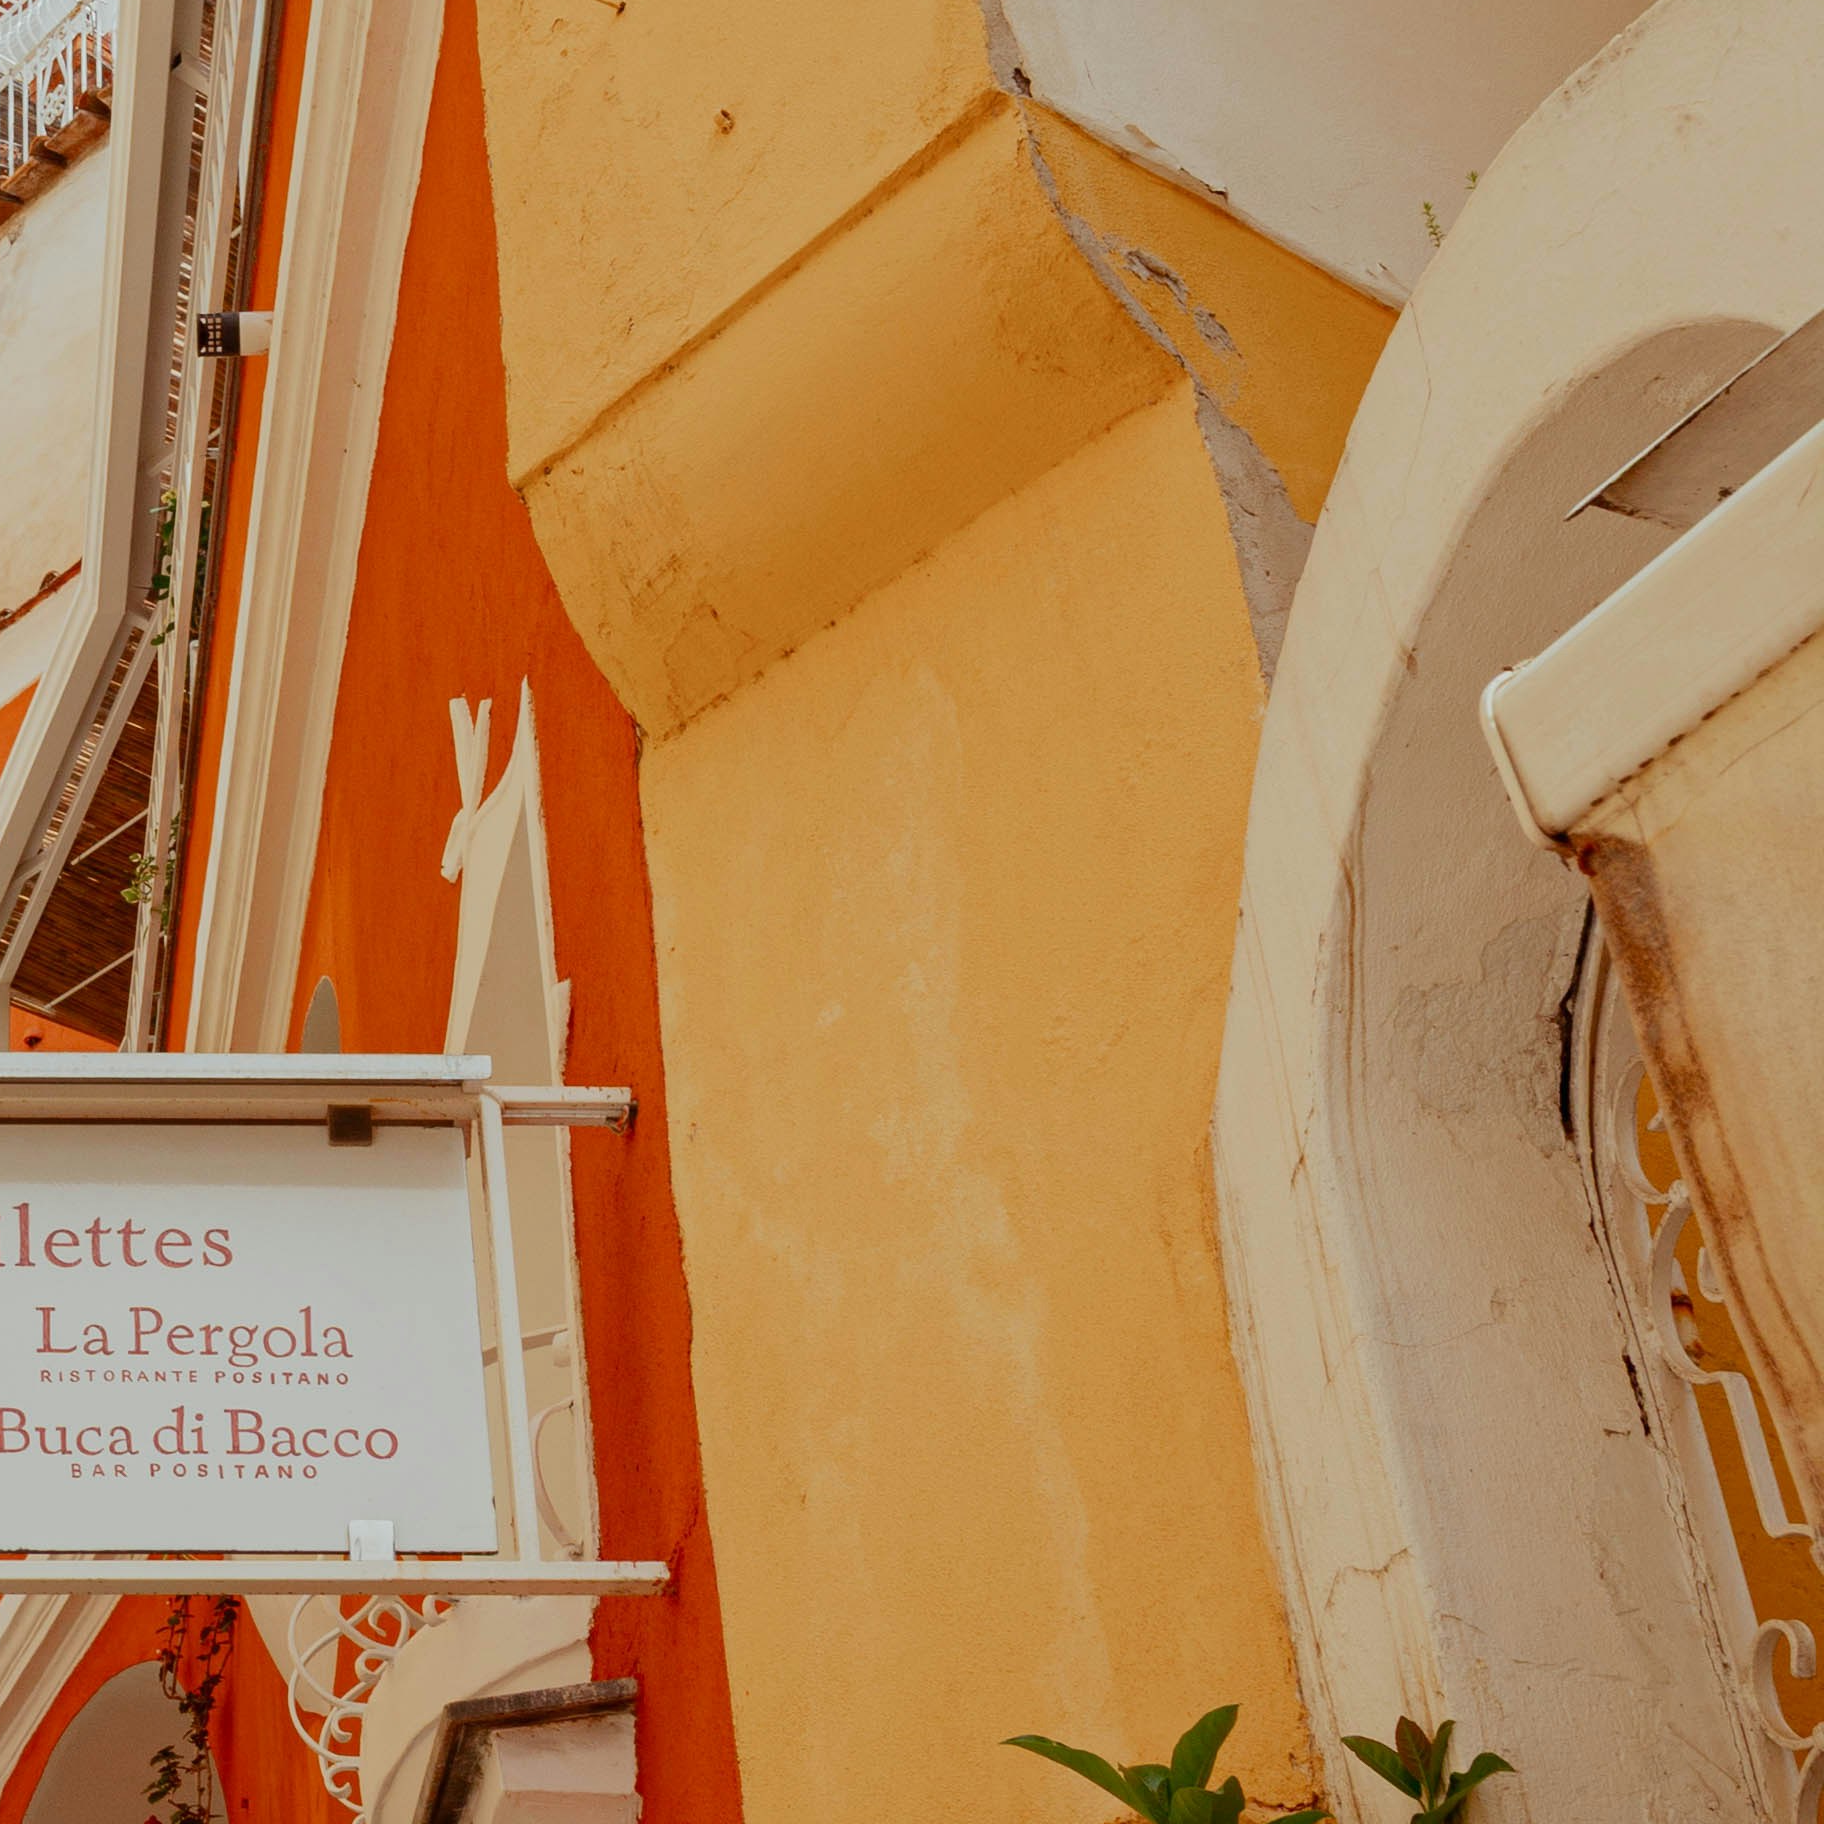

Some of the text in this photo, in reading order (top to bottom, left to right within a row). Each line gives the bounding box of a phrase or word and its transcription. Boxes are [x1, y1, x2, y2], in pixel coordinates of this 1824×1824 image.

[35, 1306, 353, 1368] La Pergola
[39, 1370, 350, 1386] RISTORANTE POSITANO
[152, 1405, 206, 1457] di
[223, 1408, 400, 1460] Bacco
[71, 1463, 319, 1480] BAR POSITANO
